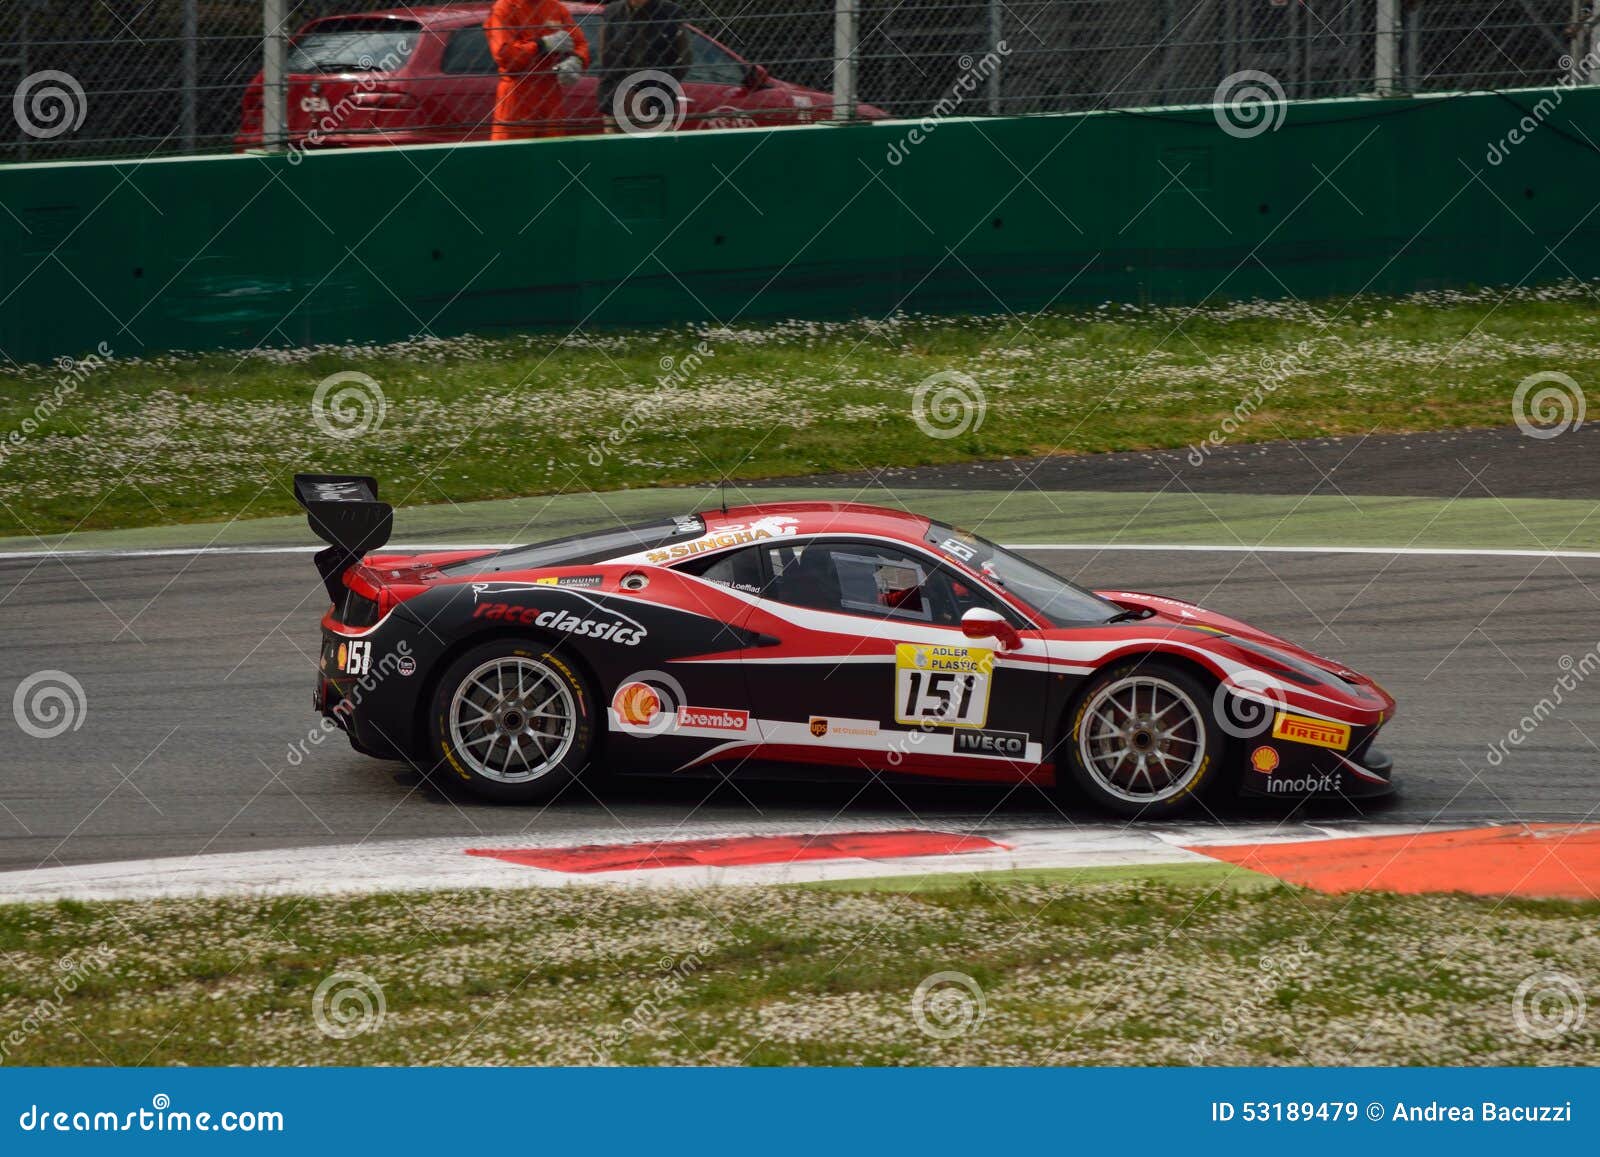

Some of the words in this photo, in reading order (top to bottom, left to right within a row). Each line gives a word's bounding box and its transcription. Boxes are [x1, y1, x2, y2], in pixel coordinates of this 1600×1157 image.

[670, 529, 772, 559] SINGHA
[559, 577, 601, 585] GENUINE
[346, 640, 372, 674] 151
[932, 648, 969, 657] ADLER
[931, 659, 978, 671] PLASTIC
[905, 672, 975, 718] 151
[680, 710, 744, 728] brembo
[1280, 719, 1345, 745] PIRELLI
[959, 734, 1022, 752] IVECO
